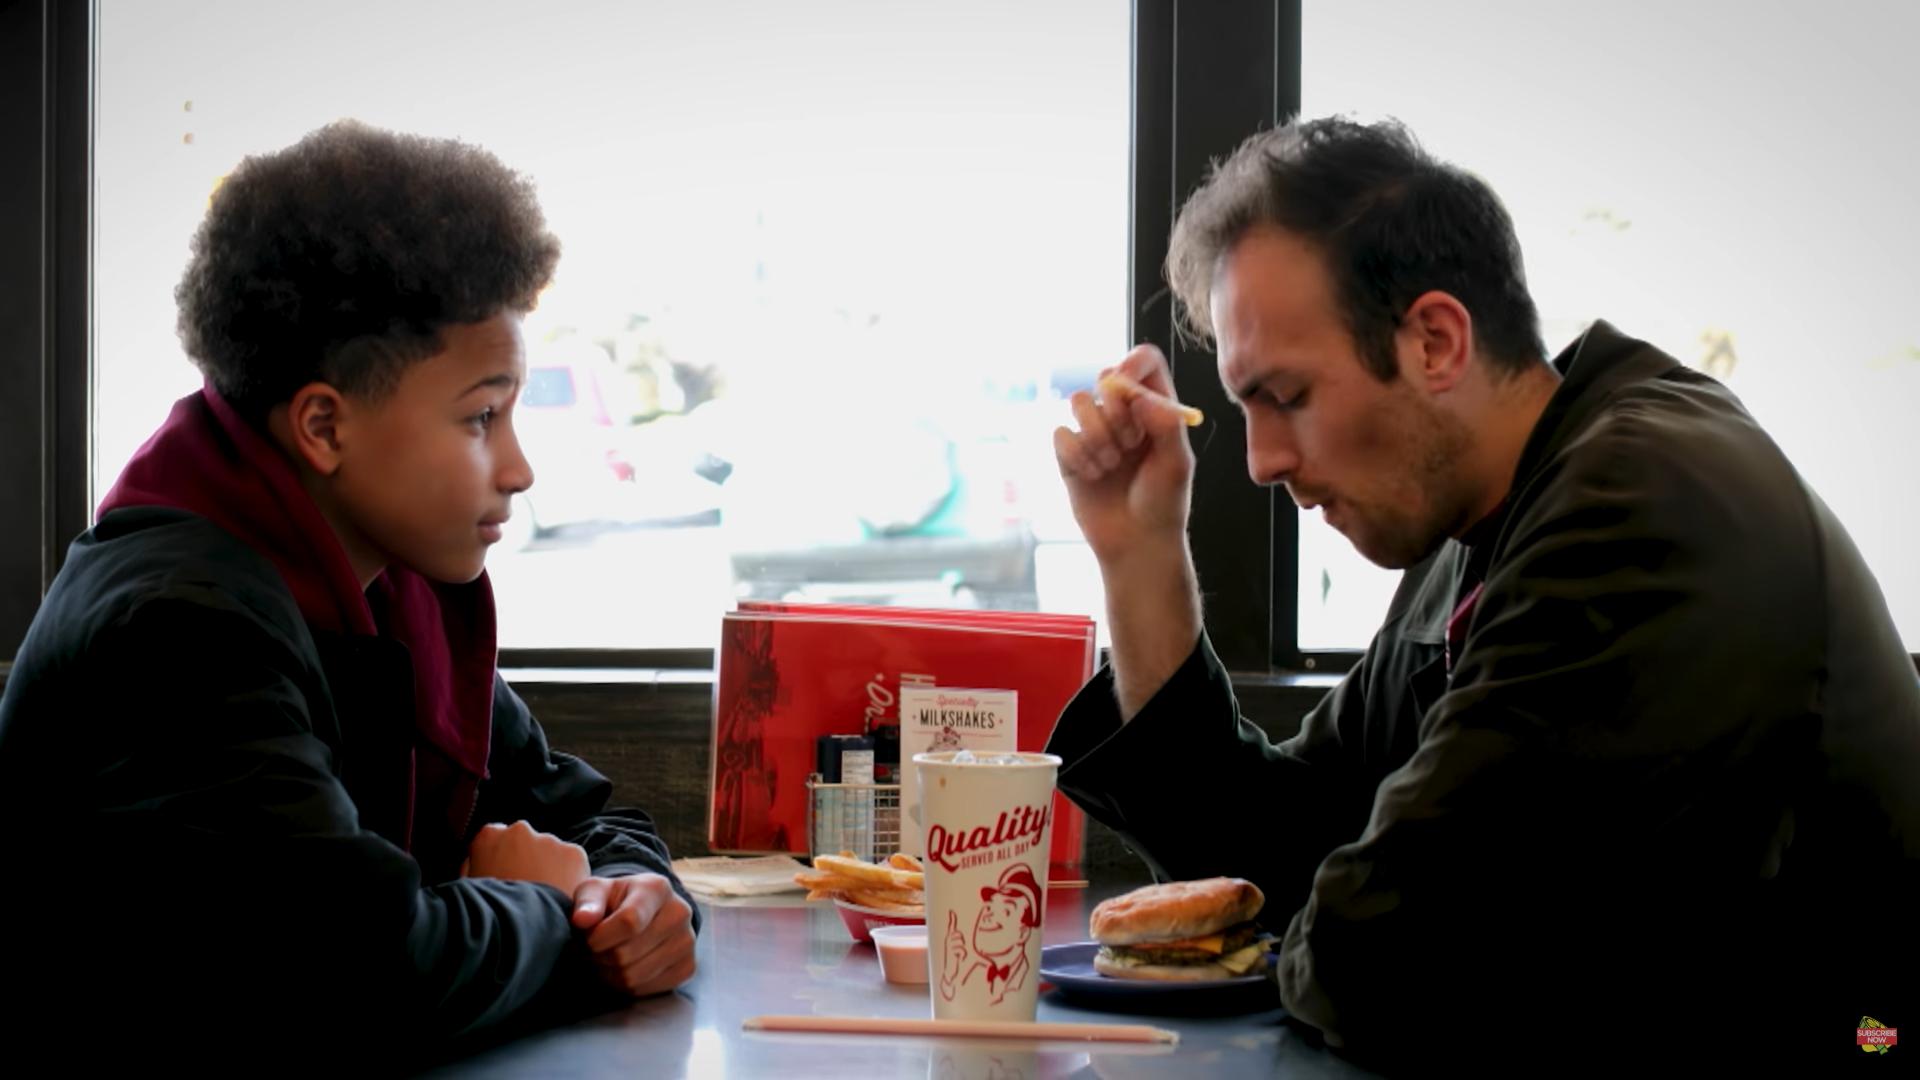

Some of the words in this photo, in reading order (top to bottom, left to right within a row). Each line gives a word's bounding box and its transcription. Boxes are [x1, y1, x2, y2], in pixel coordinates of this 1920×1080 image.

[920, 709, 995, 729] MILKSHAKES
[961, 851, 994, 869] SERVED
[996, 846, 1011, 861] ALL
[1014, 842, 1030, 857] DAY
